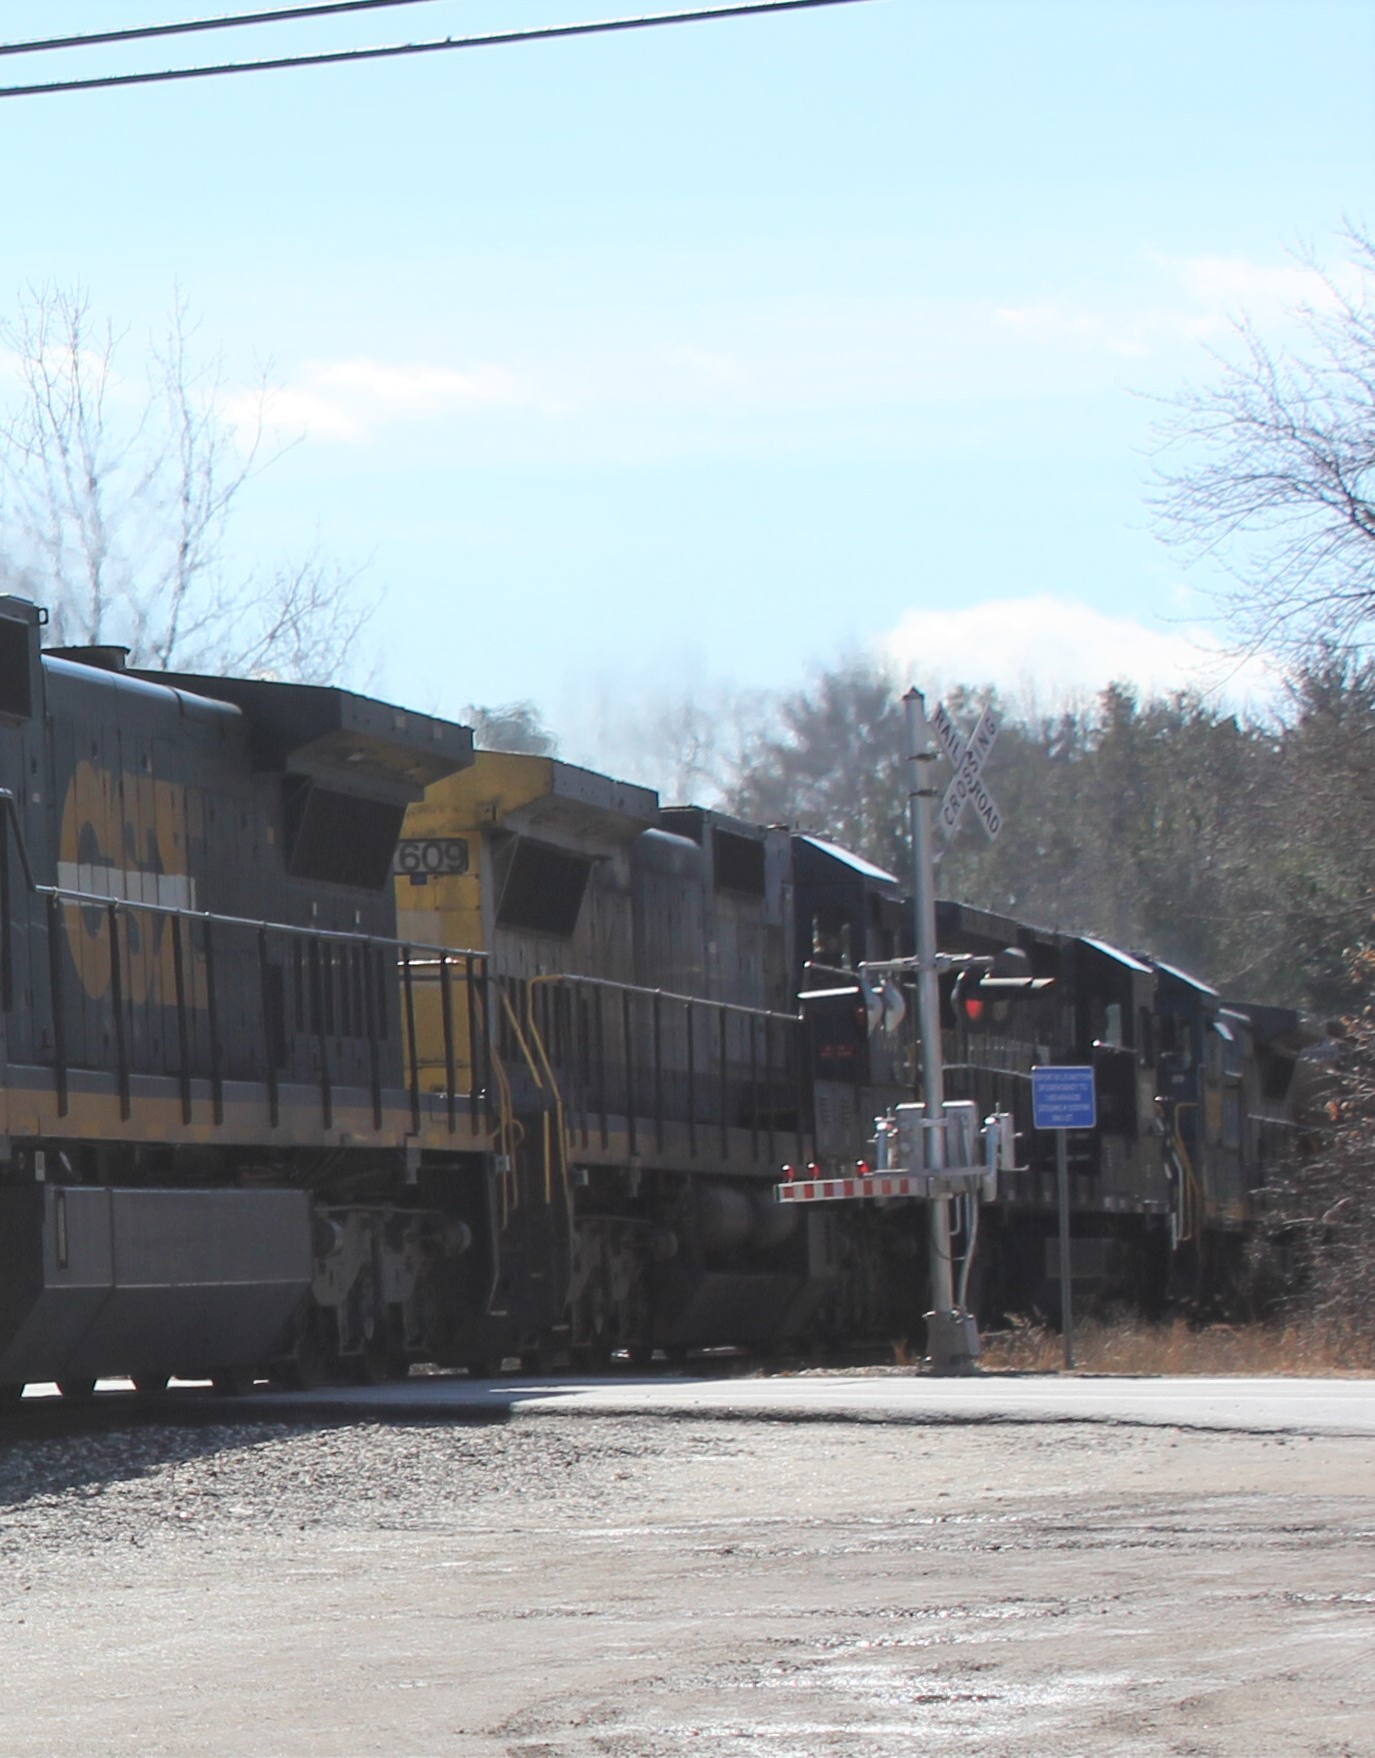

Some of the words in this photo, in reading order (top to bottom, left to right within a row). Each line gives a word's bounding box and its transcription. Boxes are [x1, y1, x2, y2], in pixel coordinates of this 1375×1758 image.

[935, 707, 960, 762] RAIL
[943, 716, 996, 826] CROSSING
[968, 780, 999, 834] ROAD
